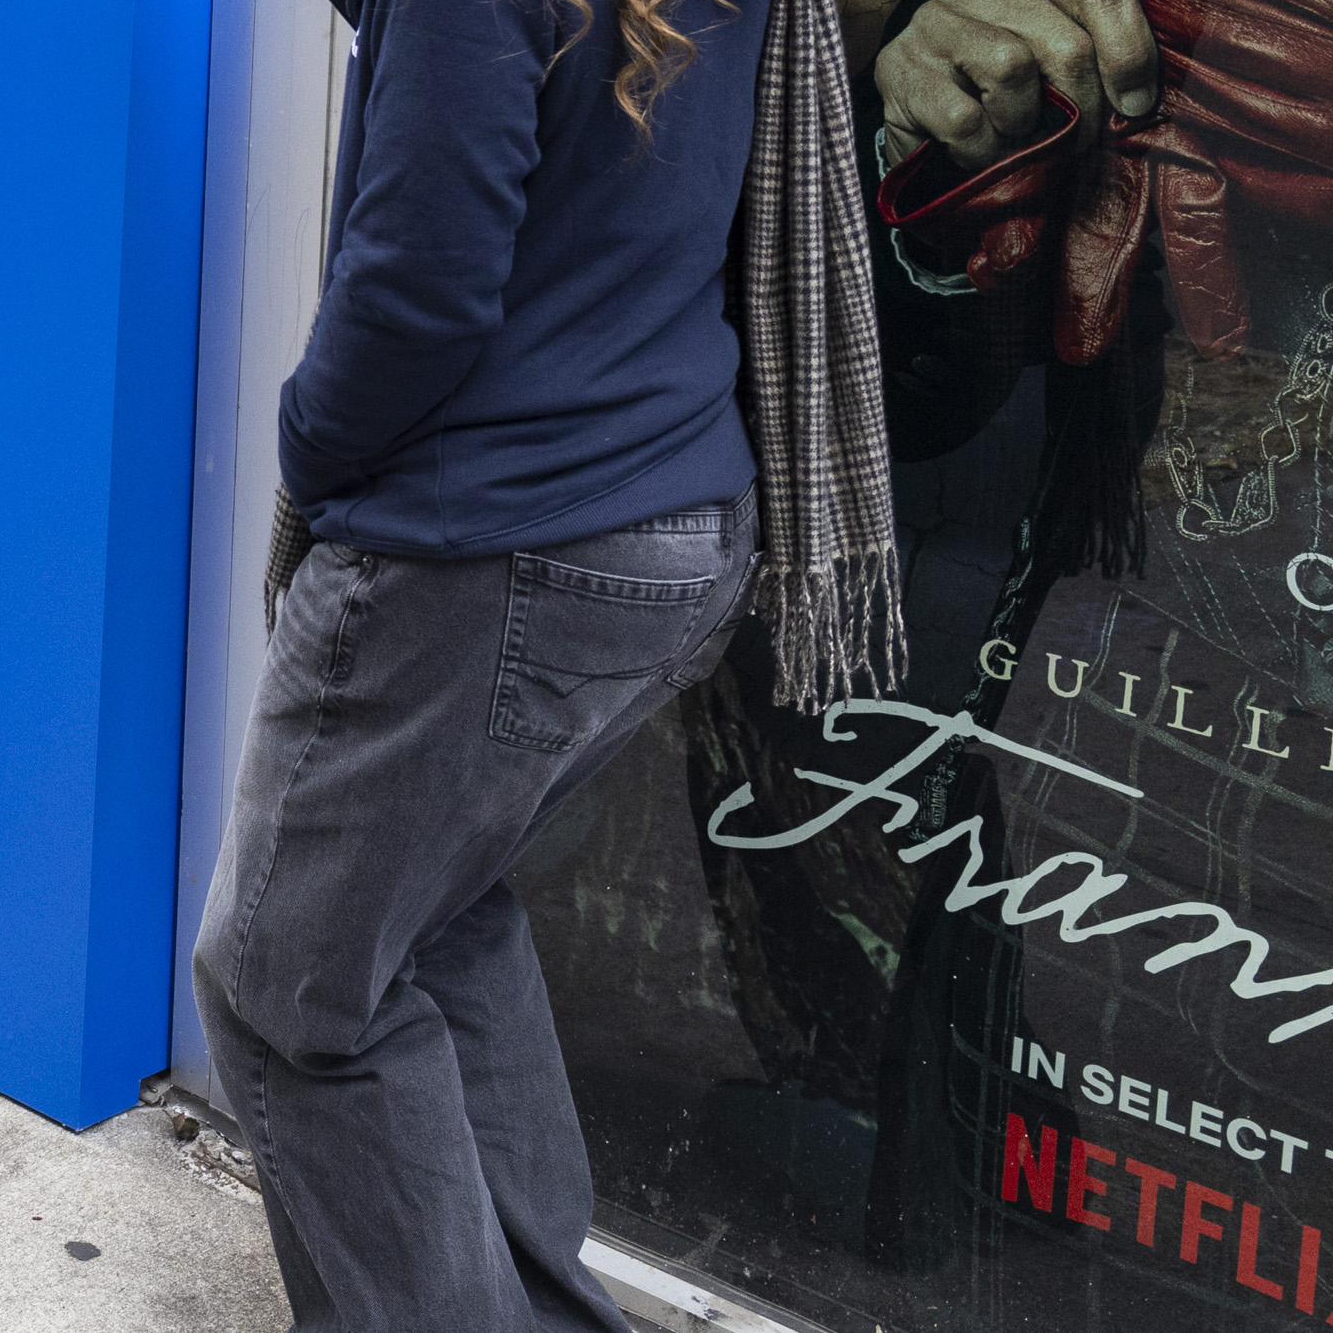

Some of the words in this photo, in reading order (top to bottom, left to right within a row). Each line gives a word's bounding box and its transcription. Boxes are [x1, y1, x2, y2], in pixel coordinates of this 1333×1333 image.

[1011, 1036, 1065, 1089] IN
[1080, 1064, 1308, 1174] SELECT
[1001, 1112, 1333, 1326] NETFLI
